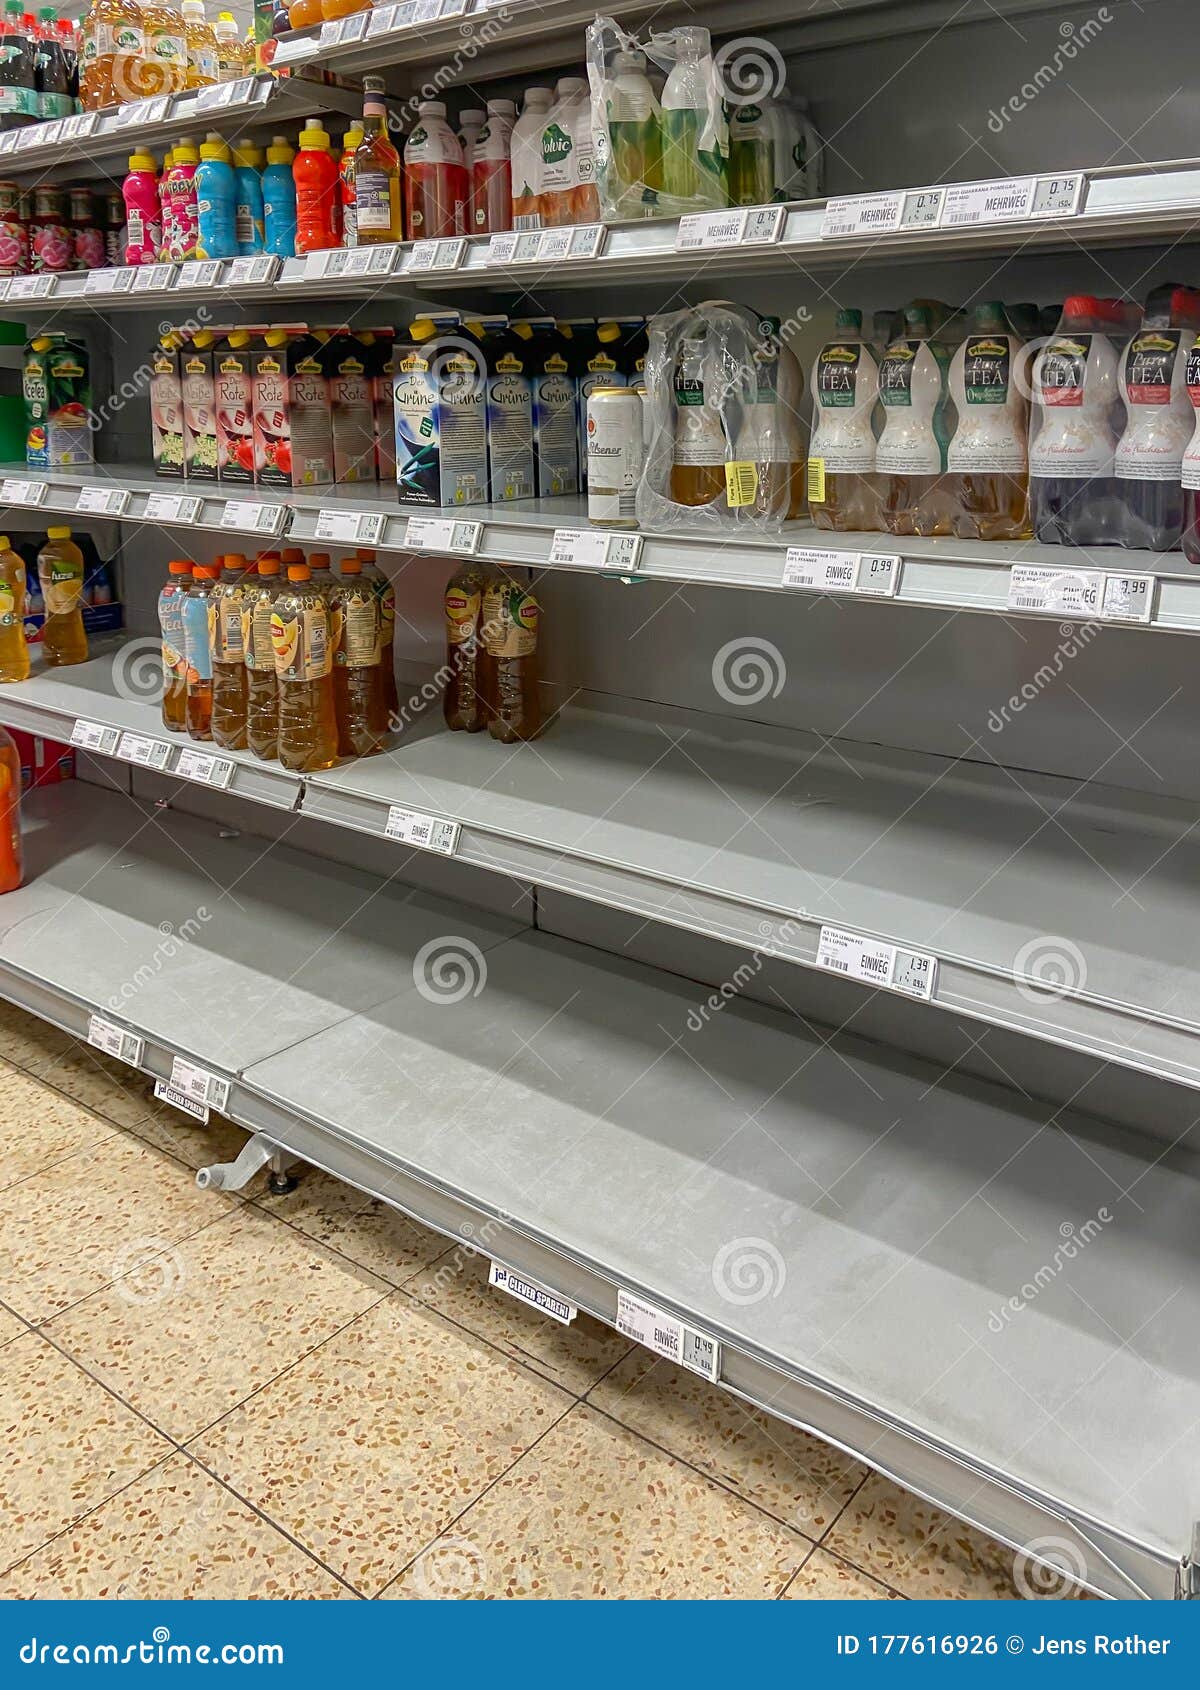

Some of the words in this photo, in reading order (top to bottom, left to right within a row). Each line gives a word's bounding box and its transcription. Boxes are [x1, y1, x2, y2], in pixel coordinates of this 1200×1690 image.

[1050, 181, 1074, 194] 0.75
[917, 195, 938, 208] 0.75
[985, 195, 1027, 211] MEHRWEG
[757, 211, 776, 224] 0.75
[860, 208, 896, 223] MEHRWEG
[707, 223, 739, 237] MEHRWEG
[974, 357, 1002, 370] Pure
[1133, 353, 1166, 366] Pure
[409, 376, 424, 386] Der
[504, 376, 520, 386] Der
[596, 375, 611, 384] Der
[820, 375, 850, 390] TEA
[881, 373, 906, 388] TEA
[968, 370, 1004, 385] TEA
[1045, 371, 1077, 386] TEA
[1128, 367, 1166, 384] TEA
[1187, 367, 1200, 385] EA
[219, 382, 245, 400] Rote
[257, 382, 283, 401] Rote
[294, 382, 324, 401] Rote
[337, 382, 366, 400] Rote
[676, 378, 700, 390] TEA
[395, 381, 434, 405] Grüne
[490, 381, 530, 405] Grüne
[826, 566, 852, 580] EINWEG
[871, 560, 892, 572] 0.99
[861, 954, 888, 974] EINWEG
[910, 957, 928, 972] 1.39
[167, 1088, 184, 1106] CLEVER
[495, 1268, 507, 1283] ja!
[508, 1275, 537, 1303] CLEVER
[536, 1290, 569, 1320] SPAREN!
[654, 1328, 678, 1351] EINWEG
[695, 1335, 713, 1354] 0.49
